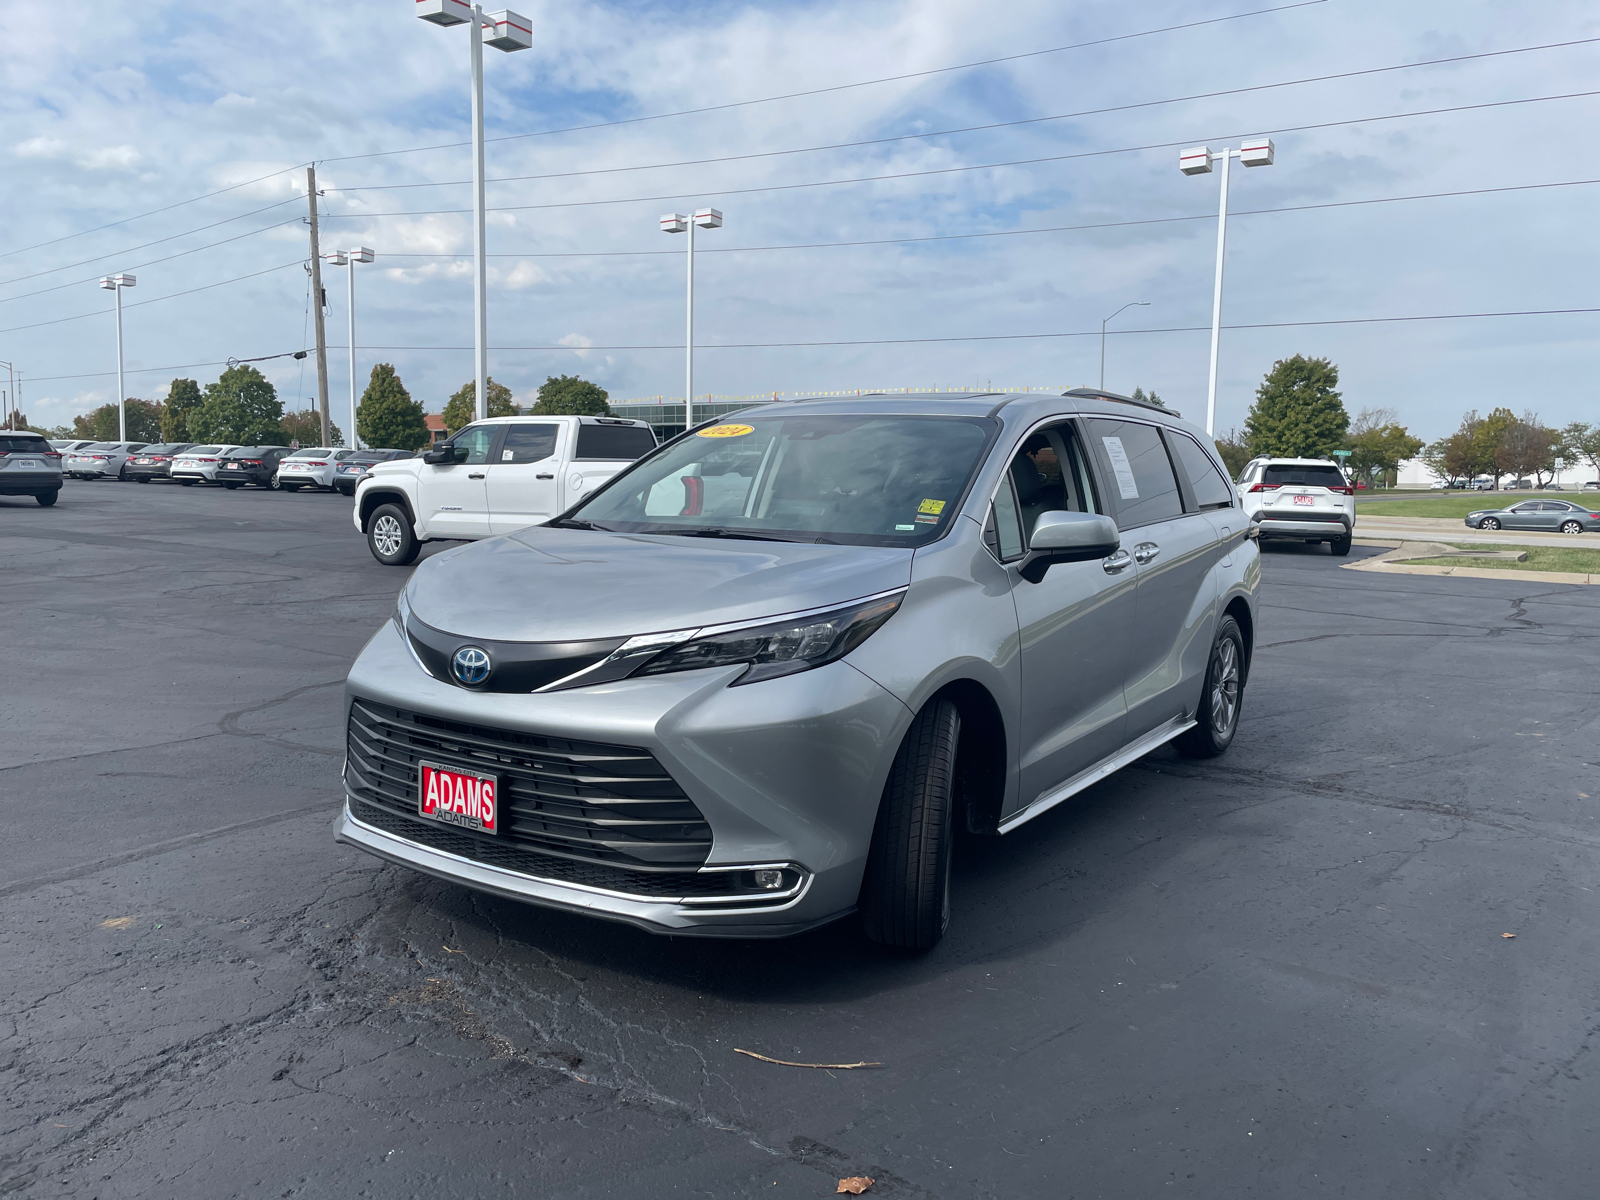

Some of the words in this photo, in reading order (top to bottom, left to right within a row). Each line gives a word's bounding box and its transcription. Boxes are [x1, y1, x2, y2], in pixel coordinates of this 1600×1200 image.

[438, 764, 462, 774] KANSAS
[425, 771, 493, 822] ADAMS
[436, 810, 479, 829] ADAMS
